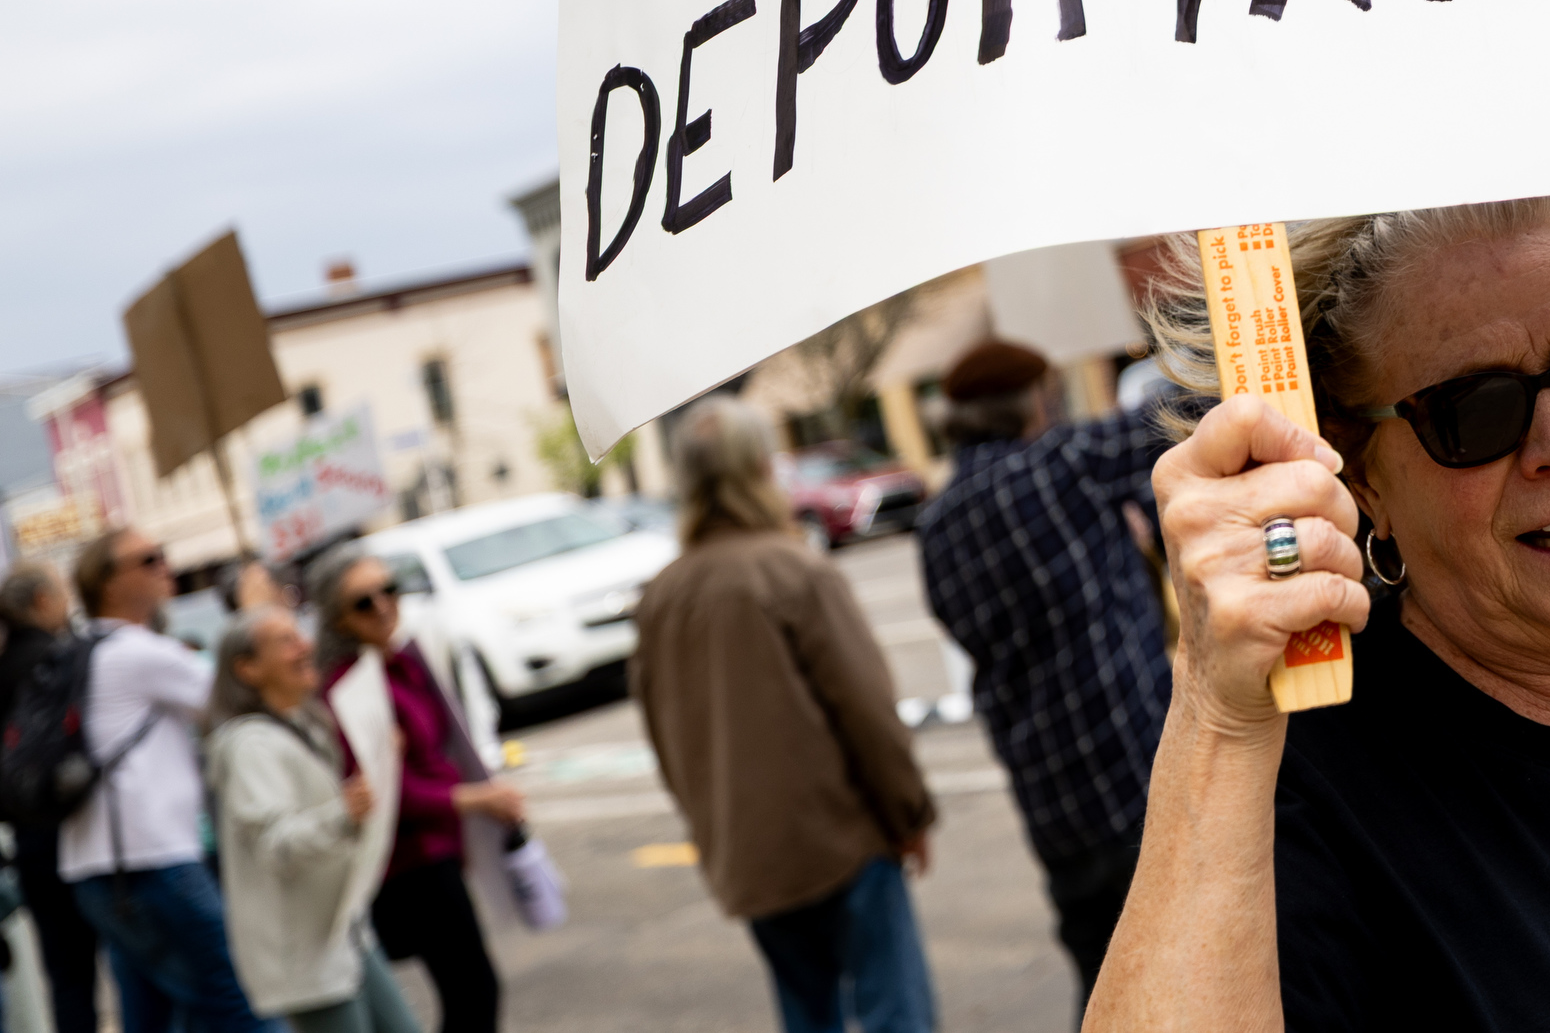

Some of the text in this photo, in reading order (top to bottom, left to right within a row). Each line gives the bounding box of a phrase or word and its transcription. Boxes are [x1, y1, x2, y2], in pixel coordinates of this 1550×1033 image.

[1210, 235, 1233, 270] pick
[1220, 275, 1233, 292] to
[1222, 297, 1242, 347] forget
[1250, 309, 1271, 382] Paint Brush
[1264, 307, 1284, 381] Paint Roller
[1271, 265, 1297, 379] Paint Roller Cover
